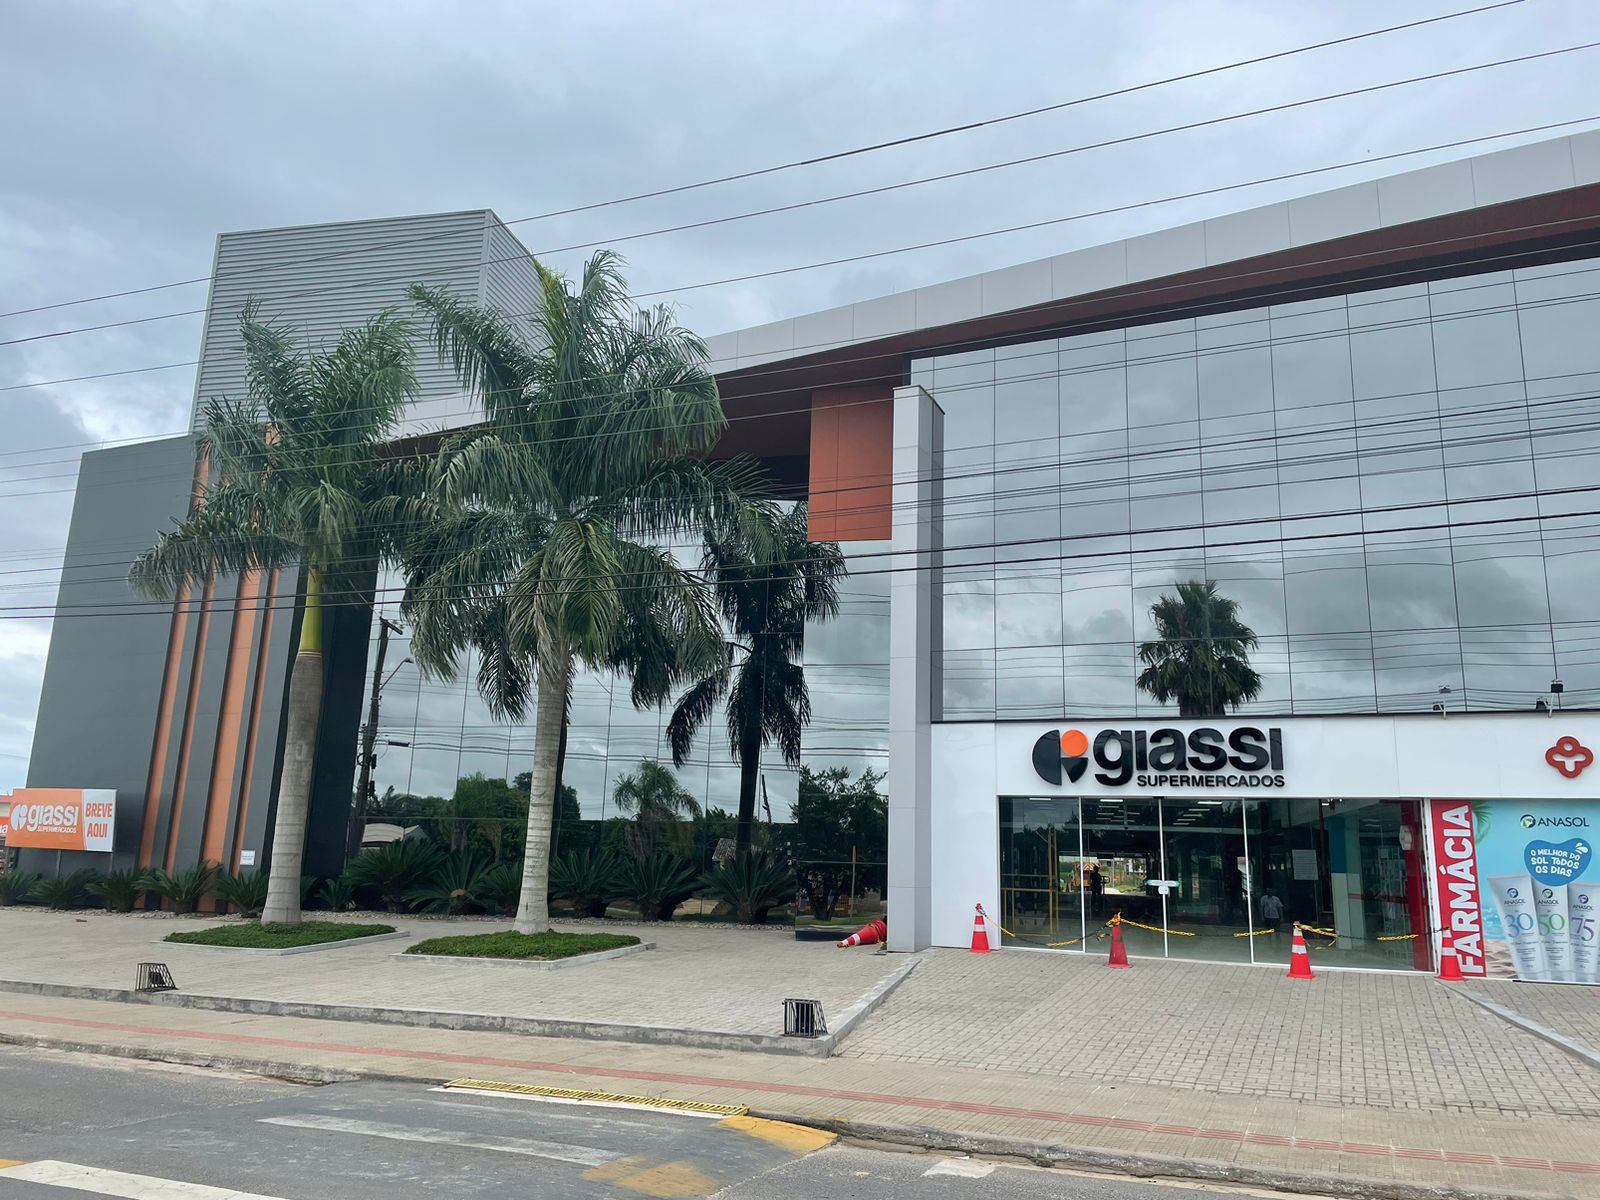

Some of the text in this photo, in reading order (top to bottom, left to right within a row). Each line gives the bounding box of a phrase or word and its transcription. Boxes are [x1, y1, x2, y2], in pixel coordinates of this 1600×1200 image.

[1092, 727, 1285, 787] giassi
[1137, 775, 1285, 788] SUPERMERCADOS
[27, 804, 79, 832] giassi
[85, 803, 113, 818] BREVE
[37, 825, 77, 833] SUPERMERCADOS
[1538, 817, 1590, 827] ANASOL
[87, 823, 108, 838] AQUI
[1537, 849, 1568, 858] MELHOR
[1569, 853, 1580, 861] DO
[1530, 857, 1580, 869] SOL TODOS
[1535, 866, 1573, 877] OS DIAS
[1439, 805, 1484, 974] FARMÁCIA
[1504, 913, 1534, 938] 30
[1538, 913, 1565, 936] 50
[1571, 917, 1595, 941] 75
